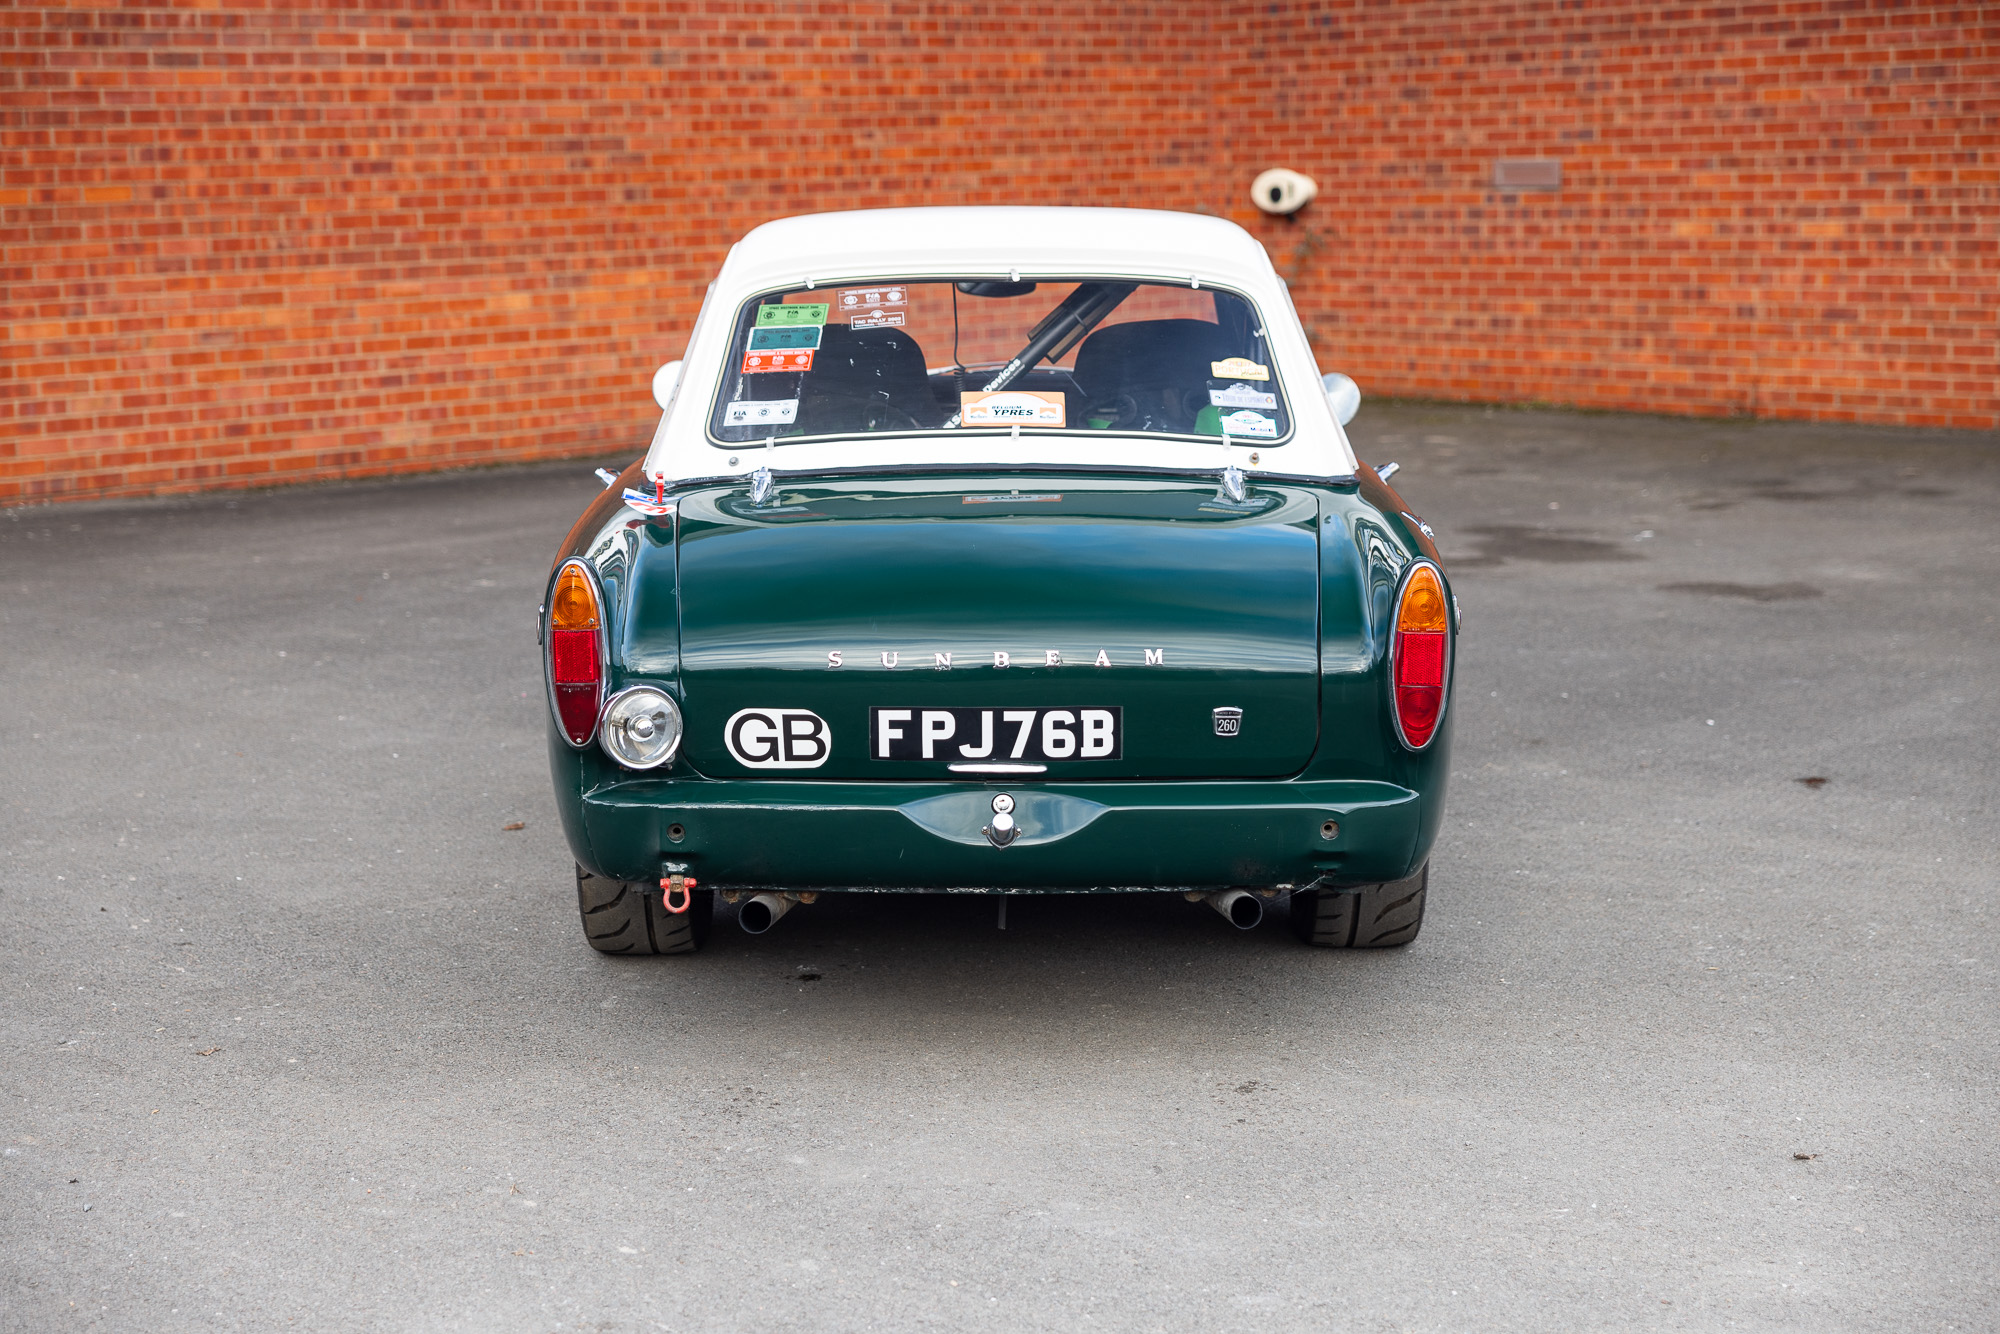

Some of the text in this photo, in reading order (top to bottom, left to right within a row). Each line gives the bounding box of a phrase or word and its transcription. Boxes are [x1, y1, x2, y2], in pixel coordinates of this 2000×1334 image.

[982, 358, 1020, 392] Devices
[828, 648, 1164, 670] SUNBEAM
[730, 712, 828, 762] GB
[878, 710, 1114, 758] FPJ76B
[1218, 719, 1237, 732] 260
